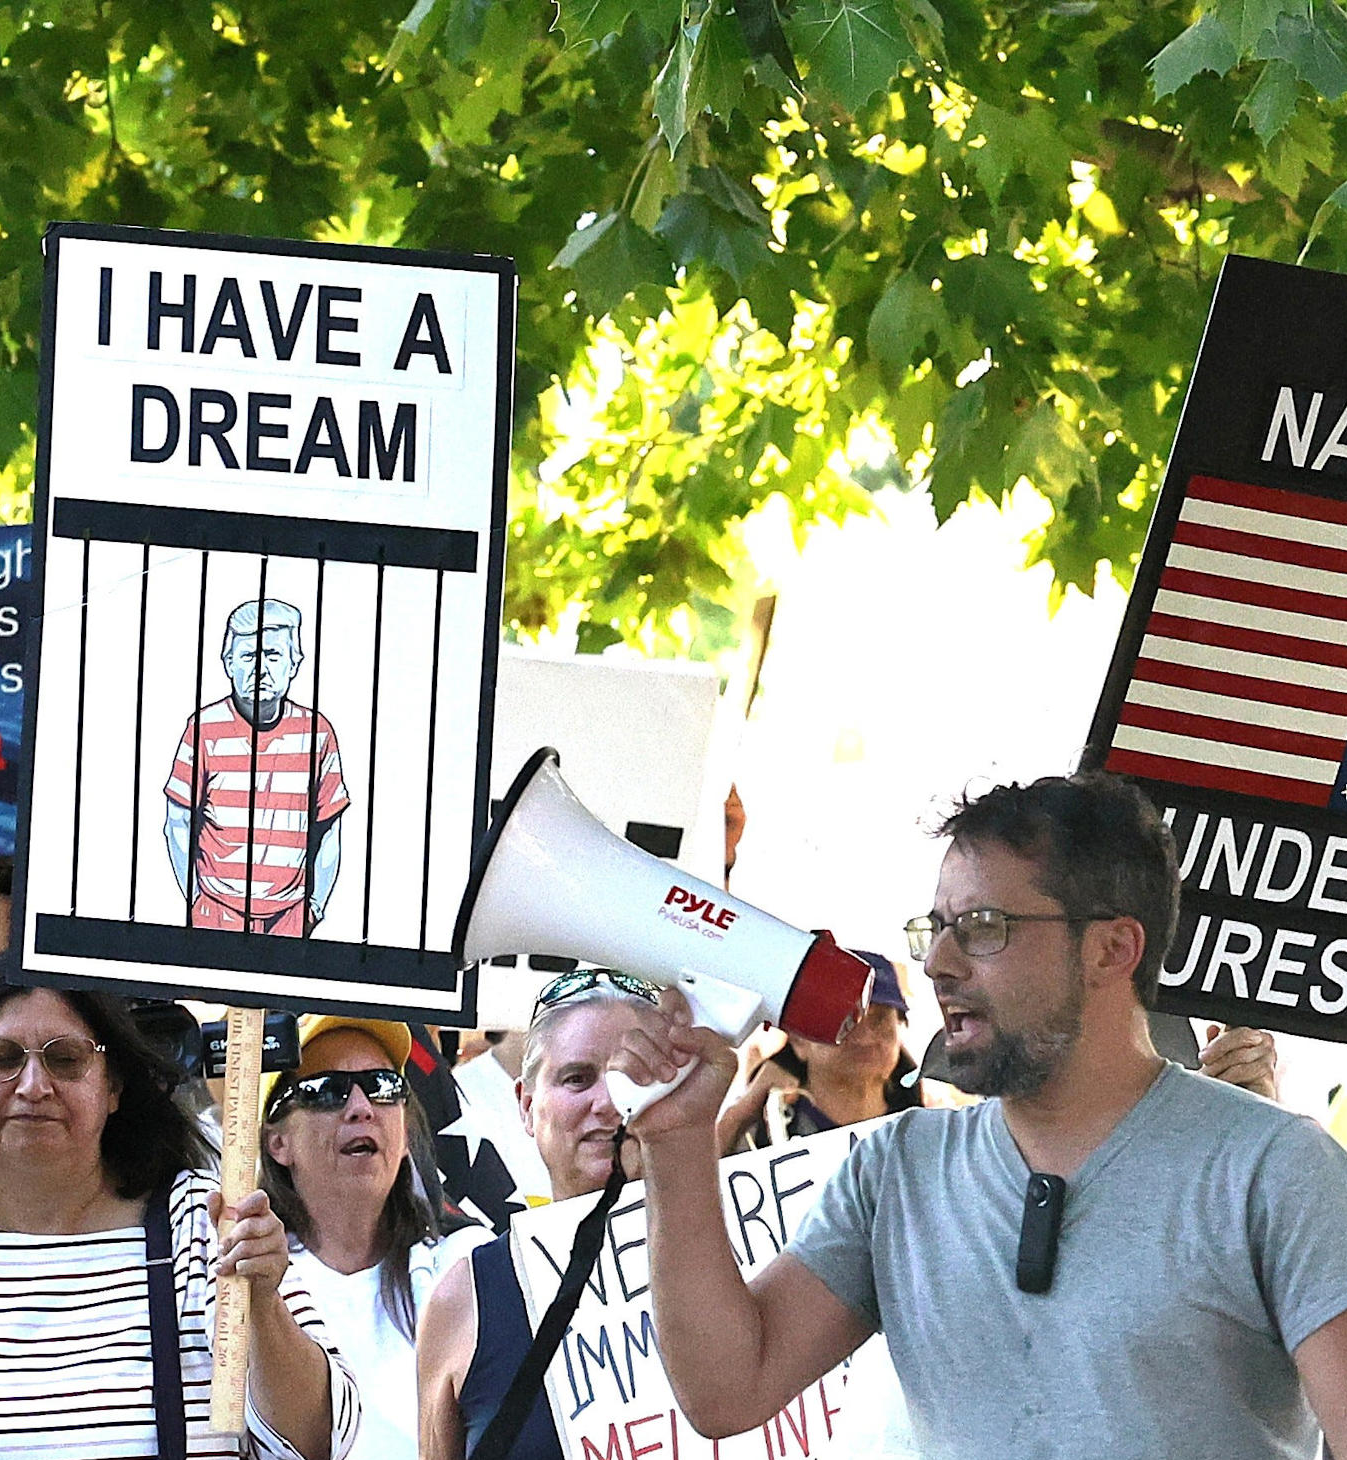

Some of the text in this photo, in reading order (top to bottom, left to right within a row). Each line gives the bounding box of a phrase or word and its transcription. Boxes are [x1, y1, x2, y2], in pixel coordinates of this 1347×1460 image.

[97, 266, 453, 376] I HAVE A
[129, 384, 418, 484] DREAM
[664, 885, 738, 931] PYLE
